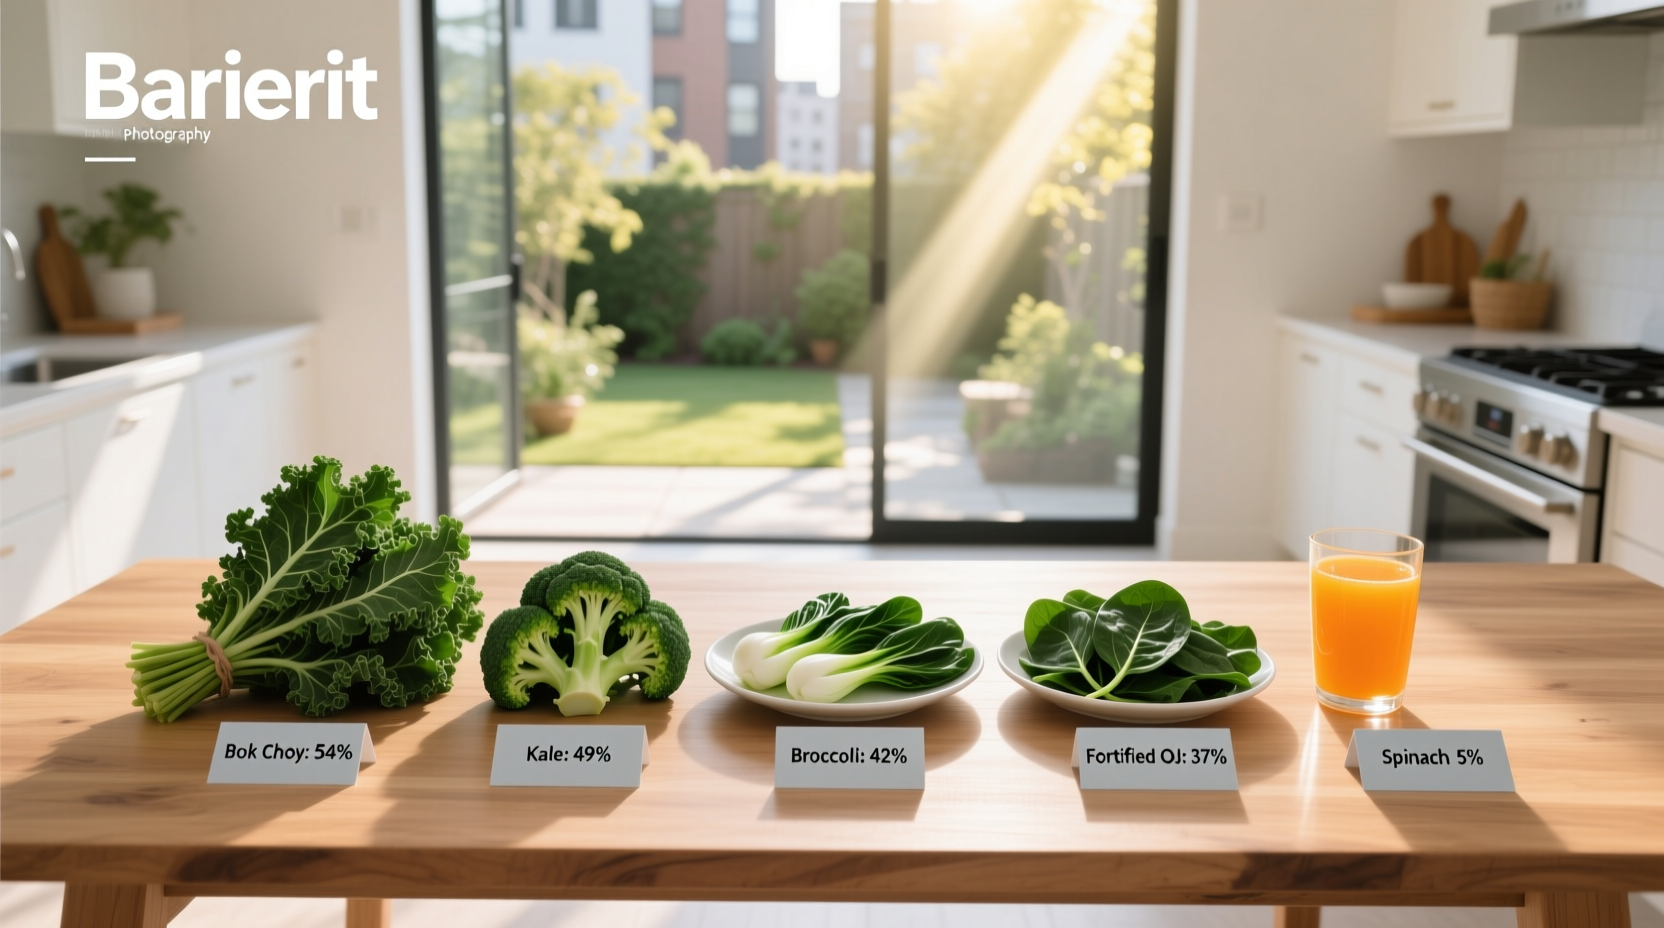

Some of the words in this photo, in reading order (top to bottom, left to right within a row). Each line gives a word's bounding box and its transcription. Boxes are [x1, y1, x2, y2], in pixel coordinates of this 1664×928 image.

[224, 742, 258, 760] Bok
[262, 742, 310, 765] Choy:
[314, 743, 353, 760] 54%
[526, 744, 569, 762] Kale:
[572, 745, 612, 763] 49%
[791, 746, 865, 764] Broccoli:
[869, 747, 908, 764] 42%
[1086, 746, 1156, 765] Fortified
[1160, 748, 1187, 766] OJ:
[1191, 748, 1228, 765] 37%
[1381, 747, 1451, 769] Spinach
[1456, 748, 1484, 766] 5%
